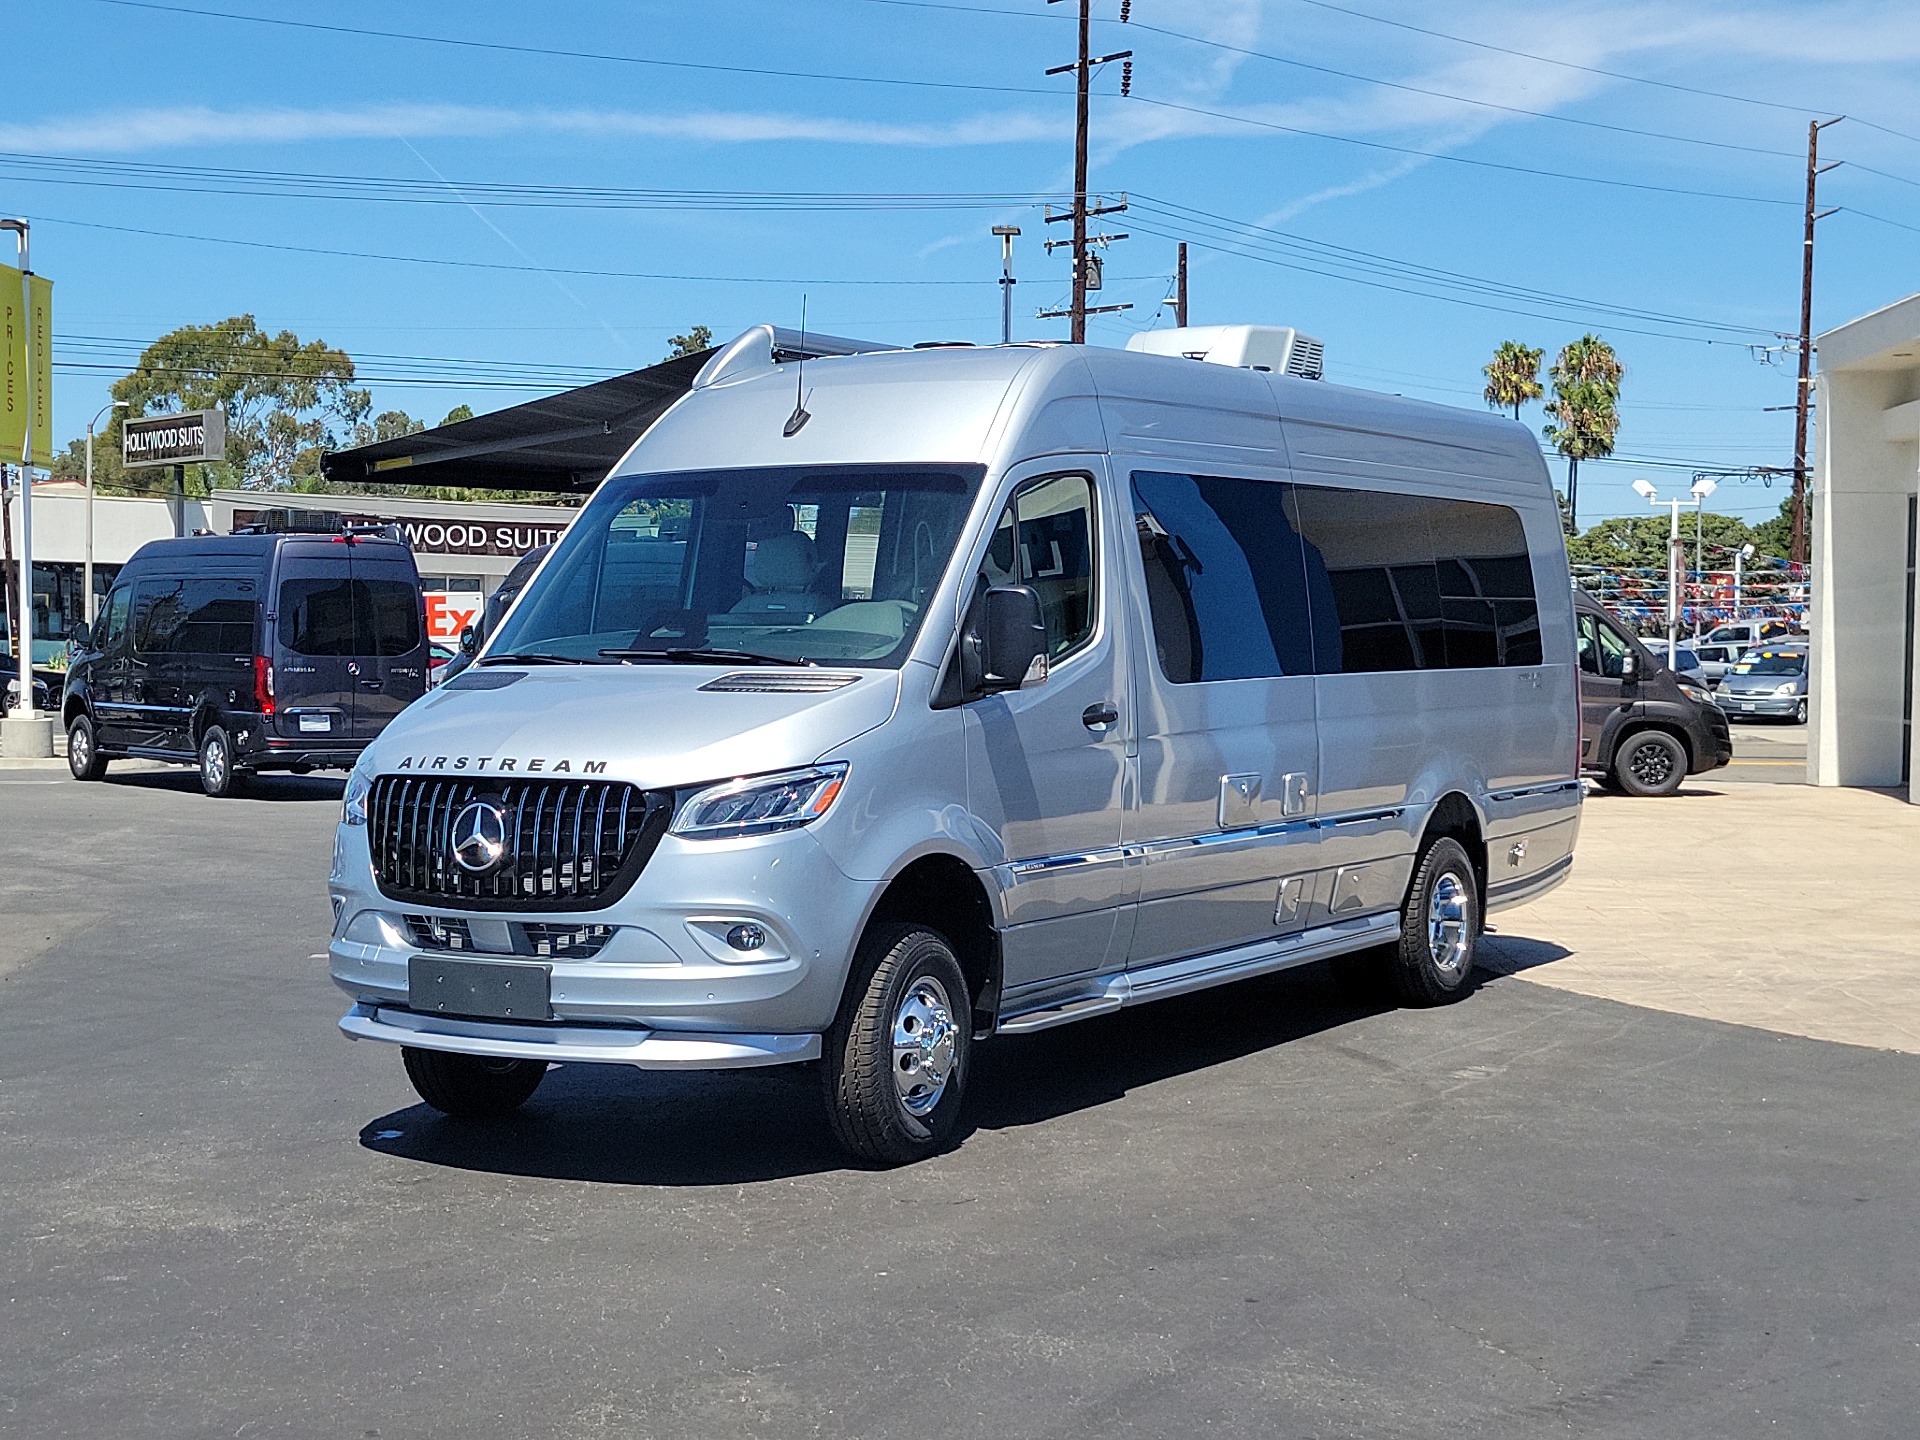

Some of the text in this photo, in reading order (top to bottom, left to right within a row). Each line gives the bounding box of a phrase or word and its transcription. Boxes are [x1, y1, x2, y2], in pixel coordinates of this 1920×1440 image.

[6, 306, 14, 413] PRICES
[124, 425, 204, 453] HOLLYWOOD SUITS
[495, 527, 564, 549] SUIT
[425, 595, 477, 636] Ex
[397, 756, 608, 773] AIRSTREAM
